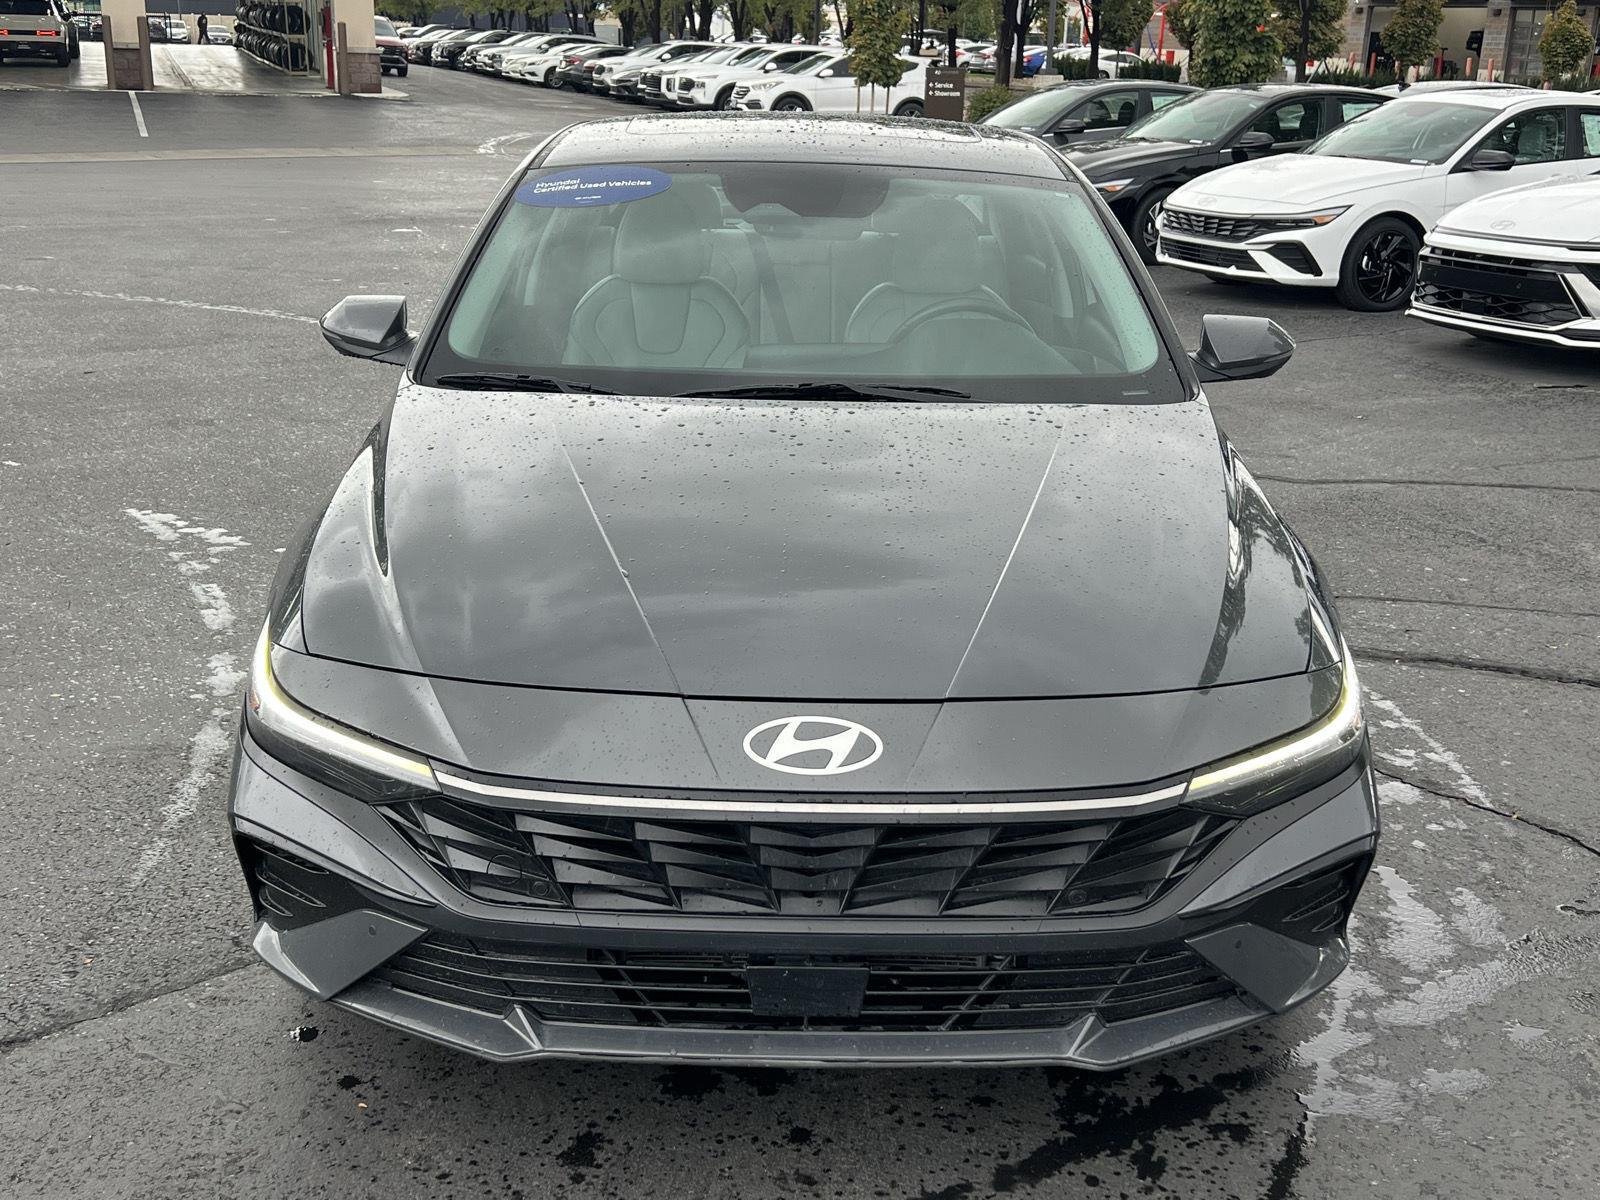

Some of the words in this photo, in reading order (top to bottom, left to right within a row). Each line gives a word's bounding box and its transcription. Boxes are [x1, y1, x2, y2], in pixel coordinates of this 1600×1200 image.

[533, 183, 578, 194] Certified
[580, 181, 606, 190] Used
[608, 180, 652, 188] Vehicles
[535, 178, 581, 188] Hyundai
